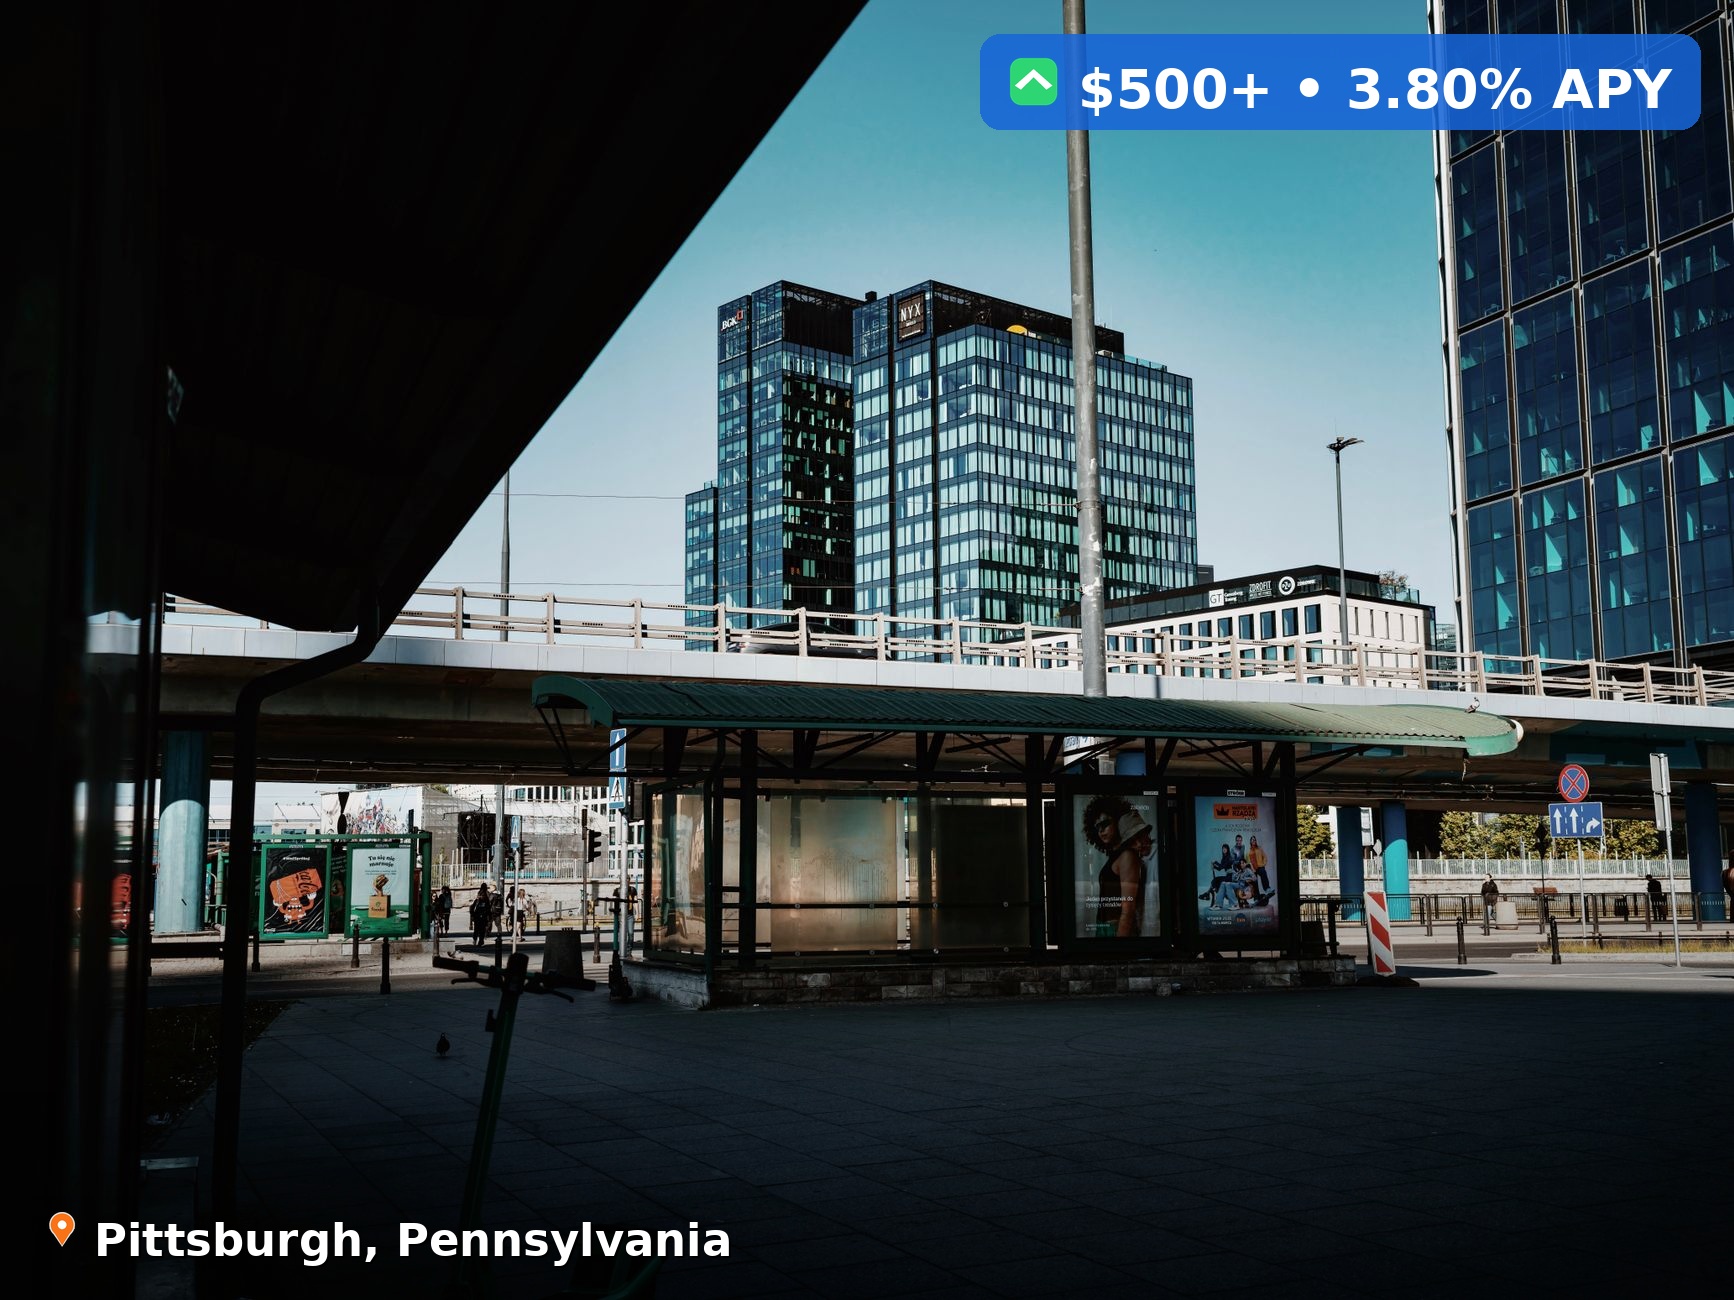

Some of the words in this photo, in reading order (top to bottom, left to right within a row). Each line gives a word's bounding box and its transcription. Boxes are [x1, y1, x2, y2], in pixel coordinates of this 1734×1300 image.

[901, 302, 921, 322] NYX
[722, 315, 738, 330] BGK
[1210, 593, 1222, 604] GT
